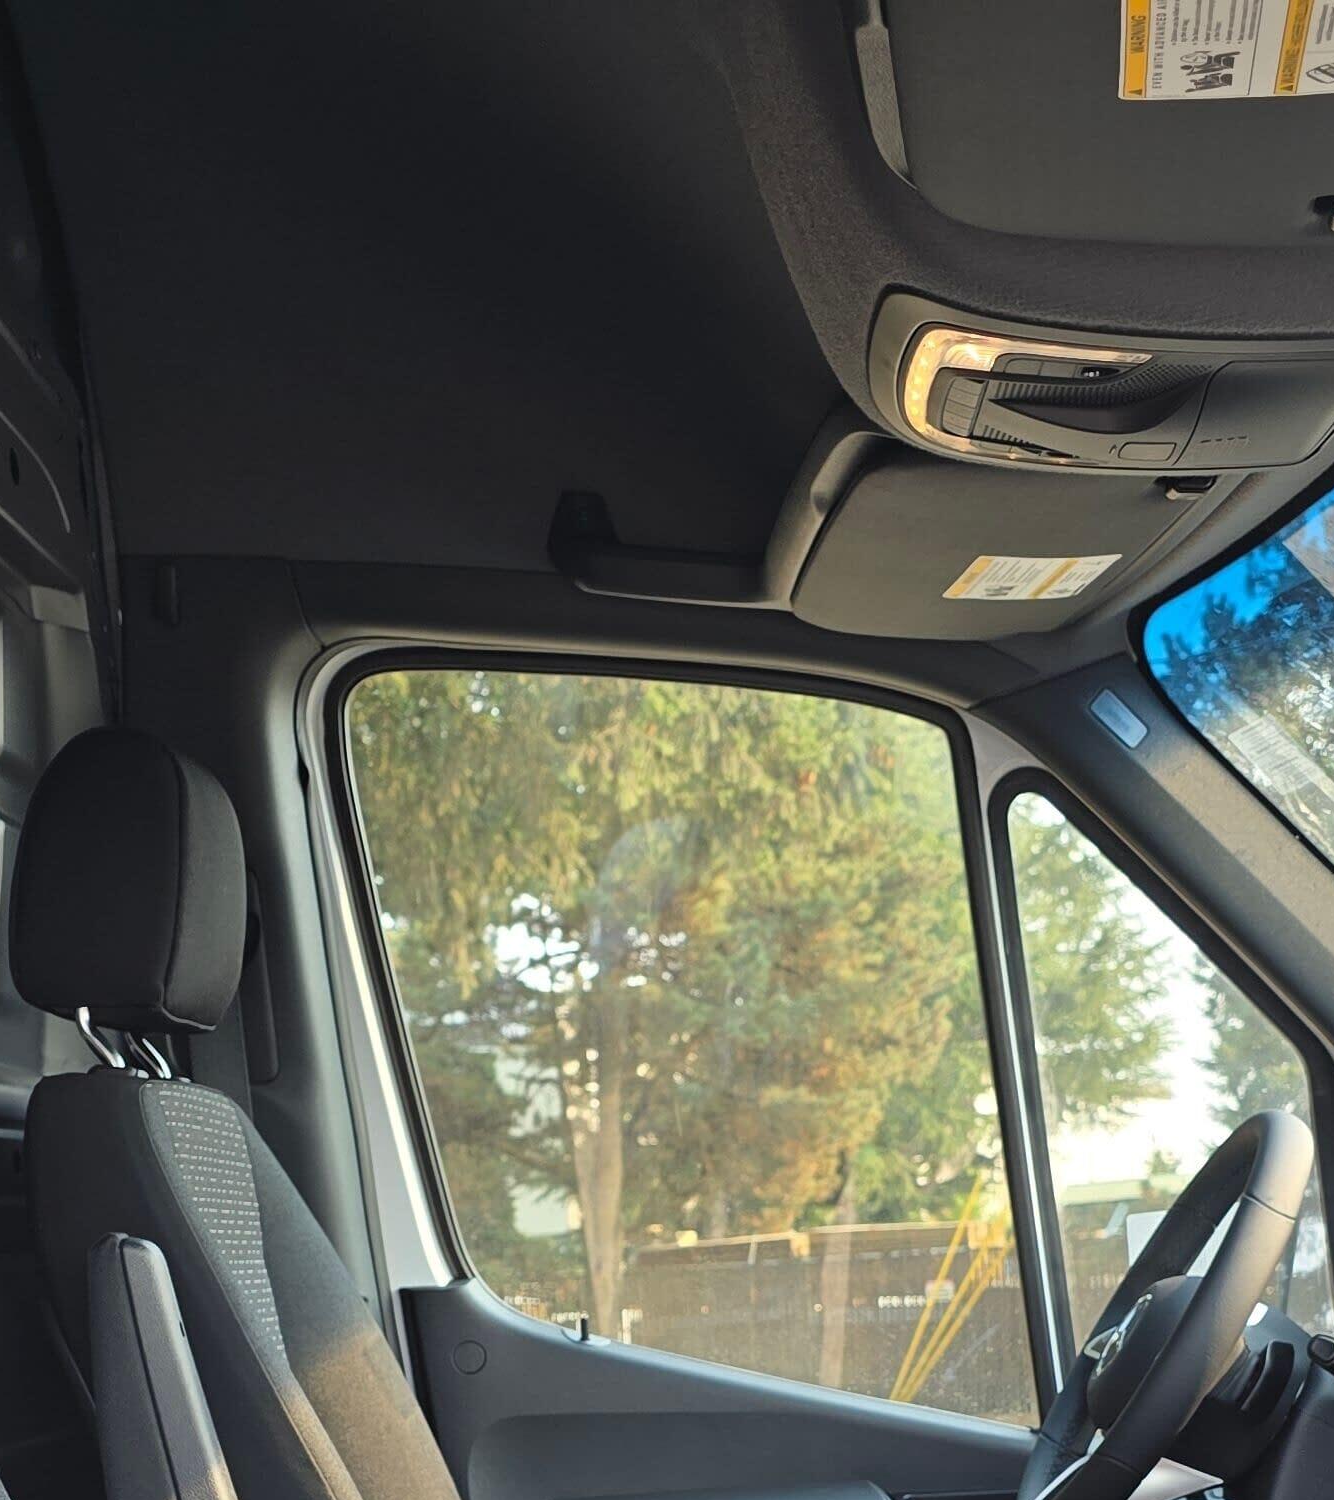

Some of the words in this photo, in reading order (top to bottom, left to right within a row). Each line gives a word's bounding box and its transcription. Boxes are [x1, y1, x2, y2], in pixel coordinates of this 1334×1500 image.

[1130, 15, 1146, 54] WARNING
[1155, 13, 1167, 49] ADVANCED
[1154, 52, 1164, 69] WITH
[1152, 72, 1163, 89] EVEN
